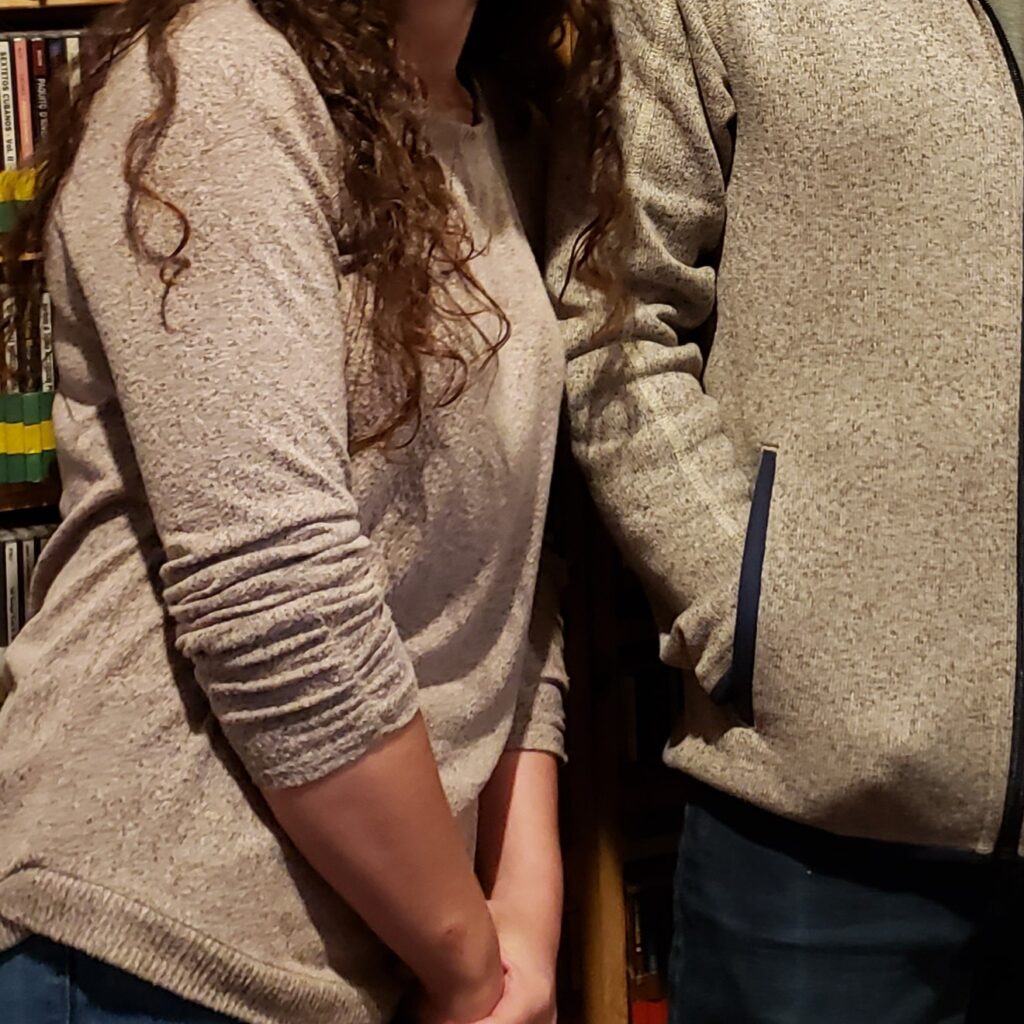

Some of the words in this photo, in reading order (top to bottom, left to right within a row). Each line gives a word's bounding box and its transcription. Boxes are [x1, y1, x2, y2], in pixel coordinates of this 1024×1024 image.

[0, 51, 9, 91] SEXTETOS
[2, 93, 12, 132] CUBANOS
[37, 78, 47, 109] PAQUITO
